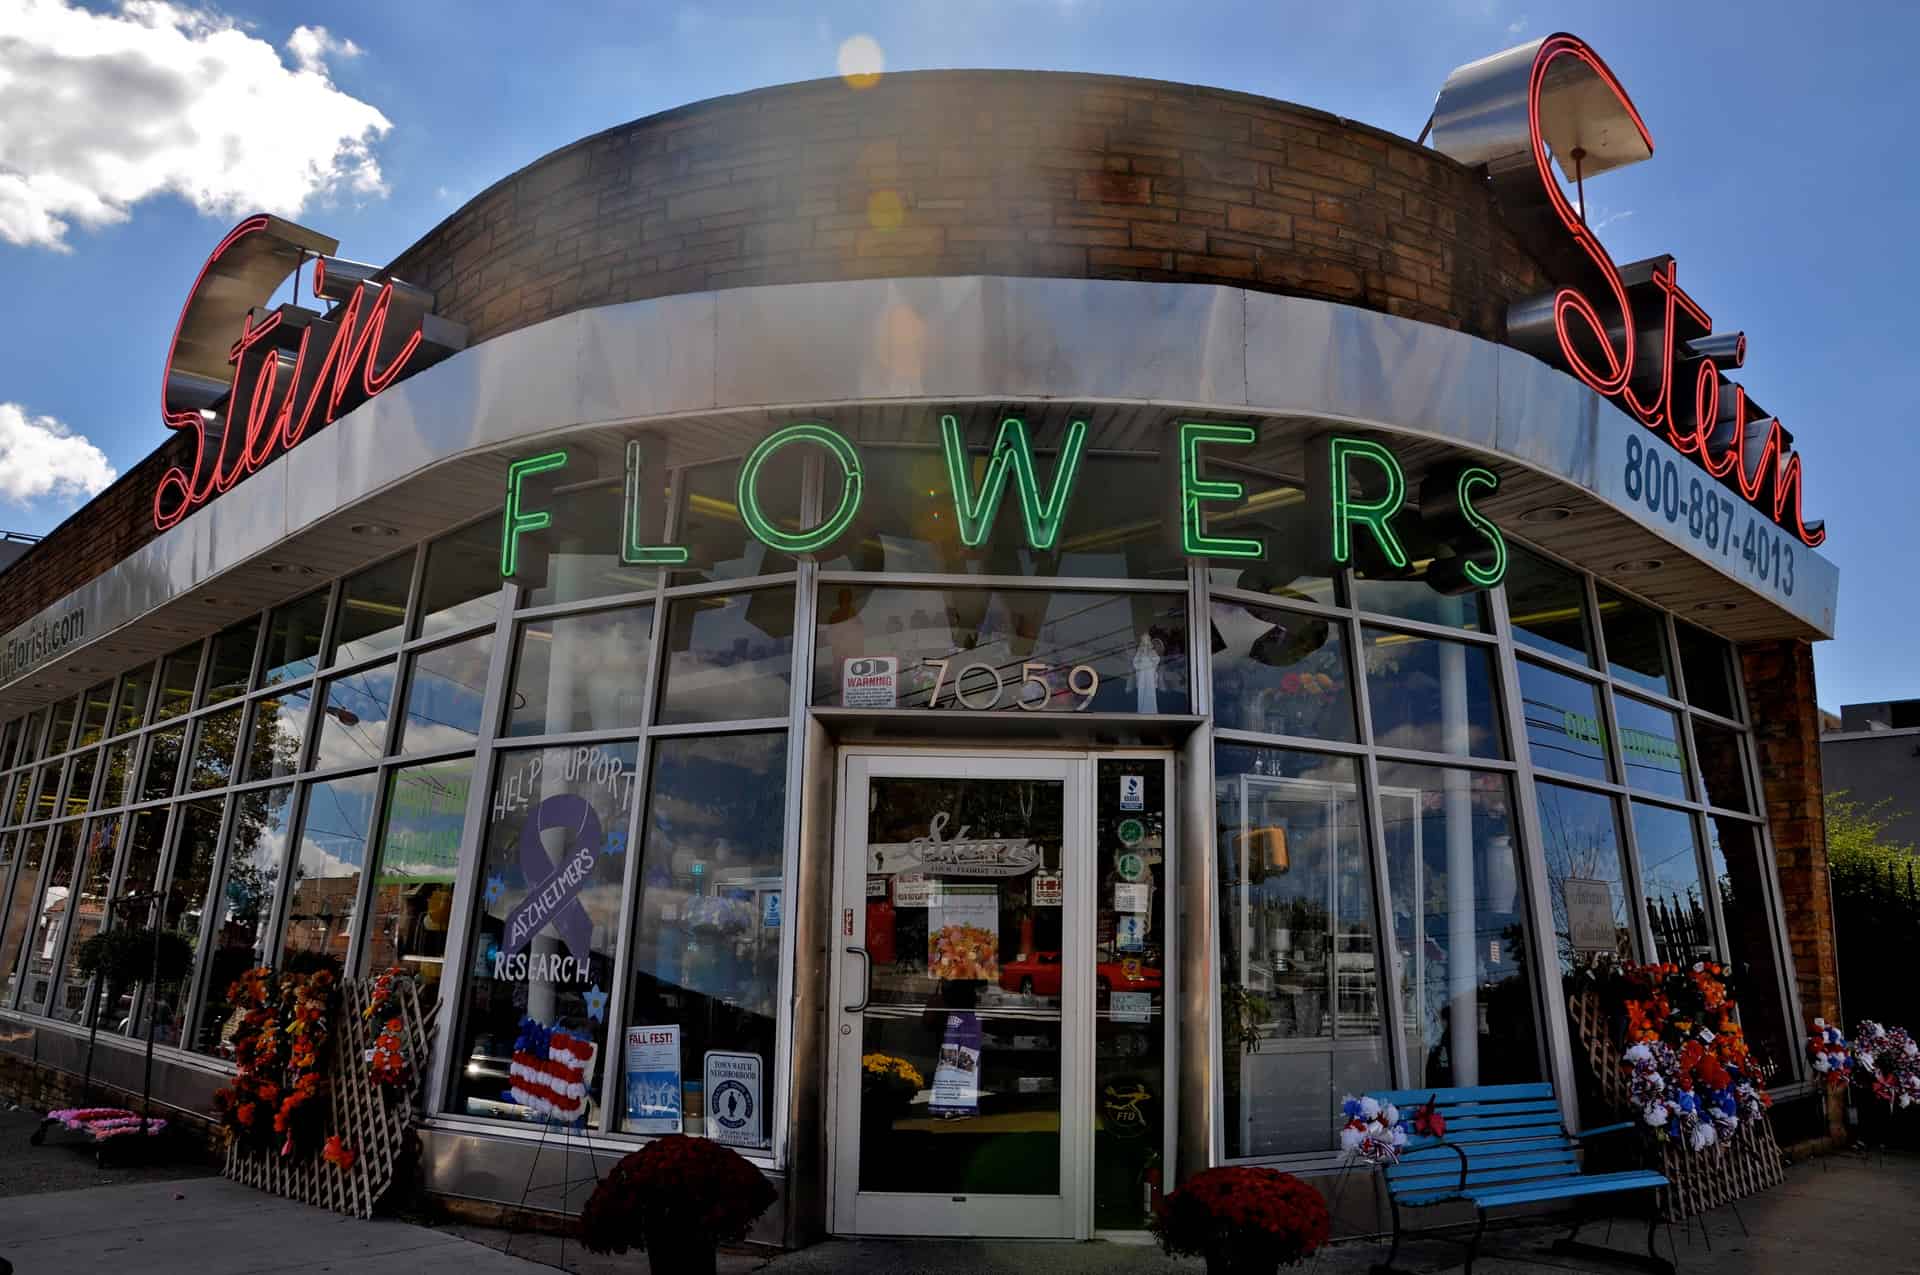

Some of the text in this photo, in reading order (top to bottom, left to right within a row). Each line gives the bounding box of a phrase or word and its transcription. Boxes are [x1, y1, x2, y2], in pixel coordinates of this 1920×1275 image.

[1528, 32, 1825, 547] Stein
[153, 213, 424, 530] Stein
[501, 414, 1508, 587] FLOWERS
[1624, 434, 1794, 597] 800-887-4013
[847, 676, 893, 688] WARNING
[922, 657, 1099, 711] 7059
[492, 757, 542, 823] HELP
[549, 746, 637, 811] SUPPORT
[629, 1032, 673, 1044] FALL FEST!
[1116, 1110, 1136, 1121] FTD
